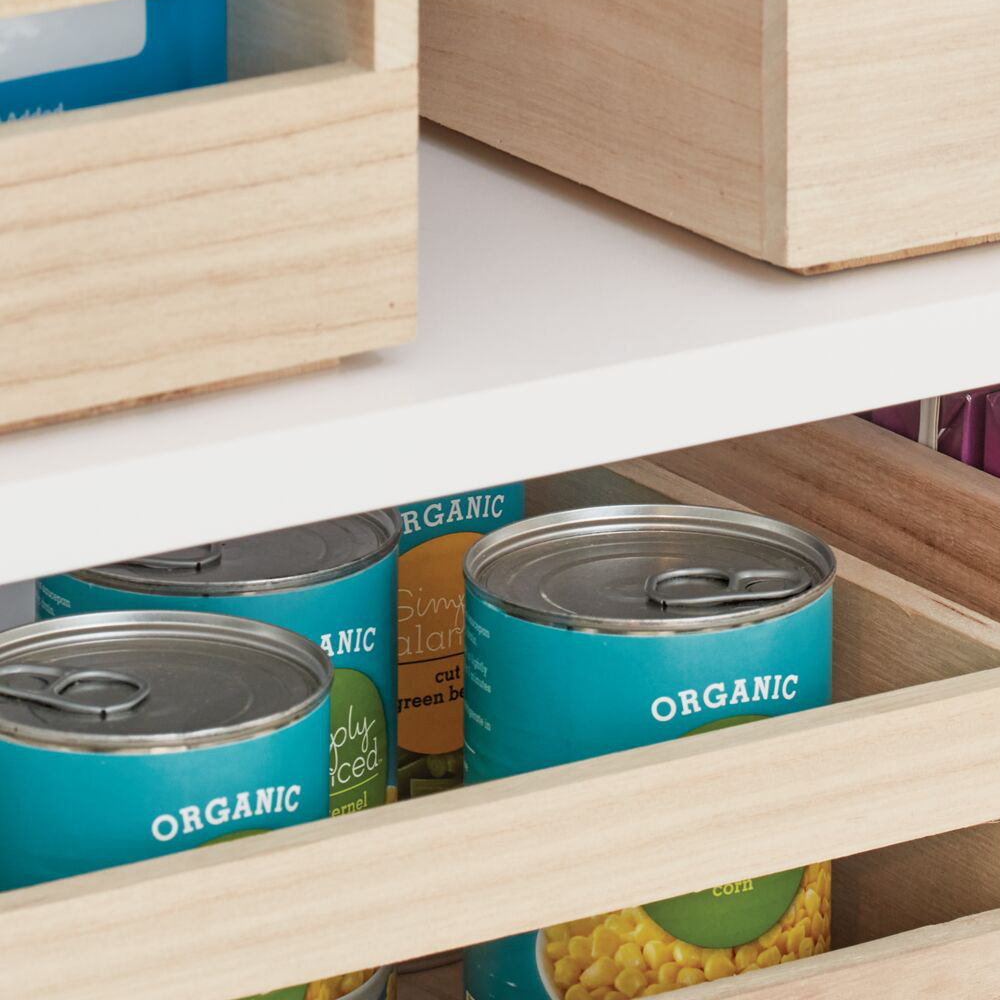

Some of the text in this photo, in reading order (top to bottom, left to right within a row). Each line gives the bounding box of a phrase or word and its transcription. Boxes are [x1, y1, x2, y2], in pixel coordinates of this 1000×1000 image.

[401, 494, 505, 535] RGANIC
[320, 627, 376, 657] ANIC
[435, 665, 460, 683] cut
[651, 674, 798, 722] ORGANIC
[151, 784, 302, 842] ORGANIC
[712, 878, 754, 897] corn
